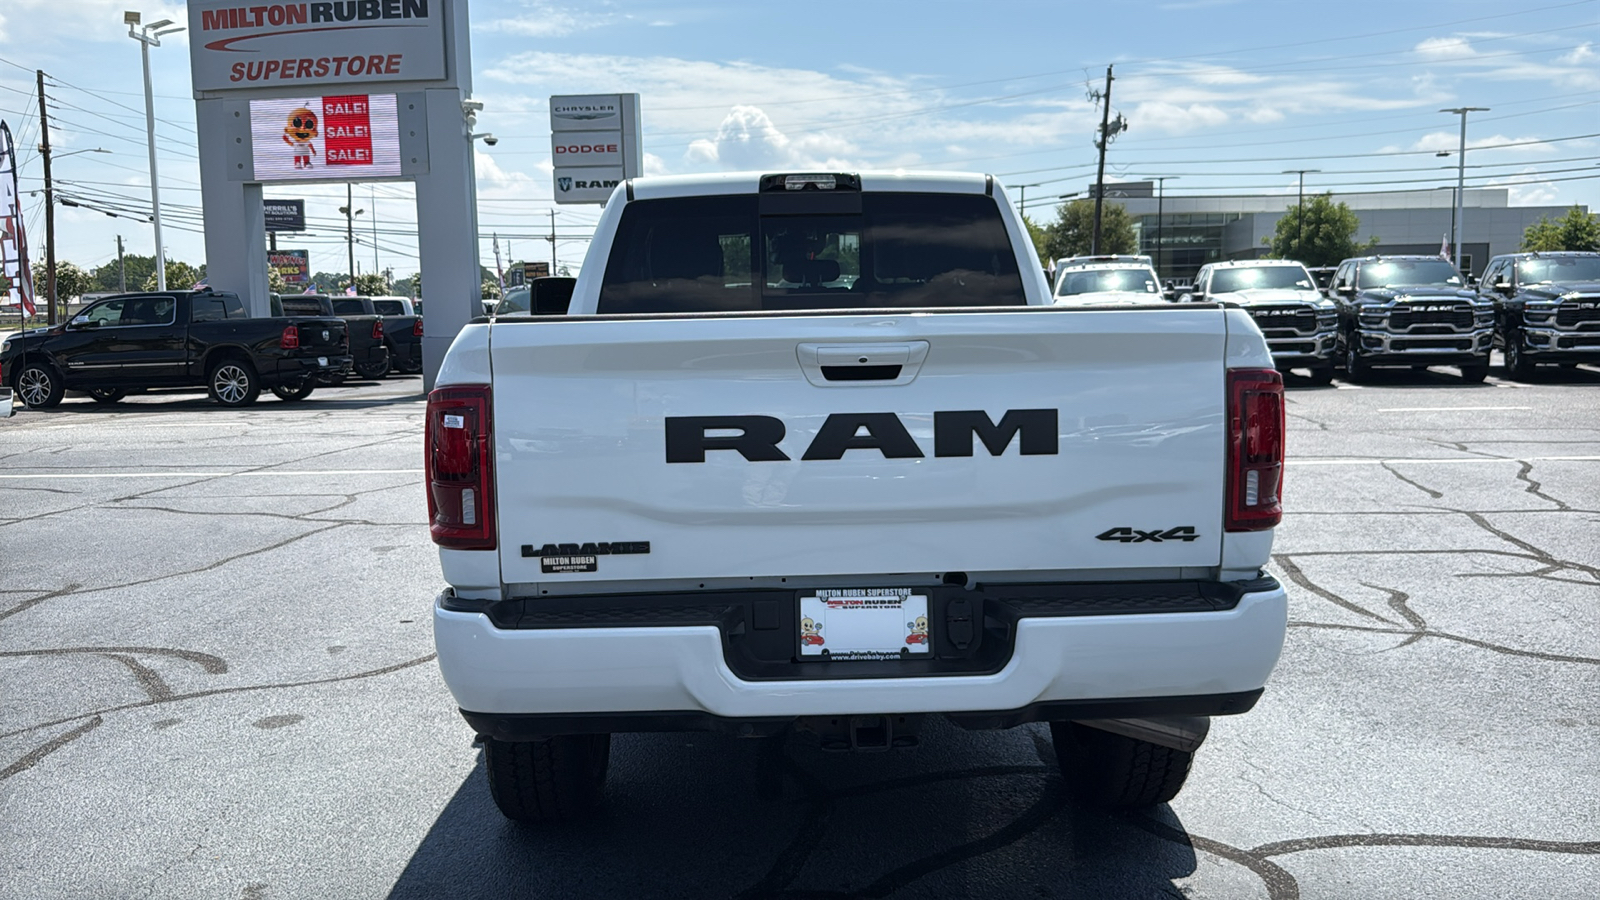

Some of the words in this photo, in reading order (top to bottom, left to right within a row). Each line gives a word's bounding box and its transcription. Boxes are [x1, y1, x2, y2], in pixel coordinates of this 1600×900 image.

[202, 4, 307, 31] MILTON
[310, 0, 429, 24] RUBEN
[229, 54, 403, 82] SUPERSTORE
[324, 102, 367, 115] SALE!
[554, 105, 615, 113] CHRYSLER
[326, 125, 369, 138] SALE!
[327, 148, 370, 162] SALE!
[555, 144, 618, 154] DODGE
[575, 179, 619, 189] RAM
[1255, 309, 1296, 317] RAM
[665, 408, 1059, 464] RAM
[1095, 526, 1200, 542] 4x4
[543, 556, 570, 566] MILTON
[571, 556, 595, 565] RUBEN
[816, 589, 841, 598] MILTON
[842, 588, 866, 597] RUBEN
[867, 587, 912, 597] SUPERSTORE
